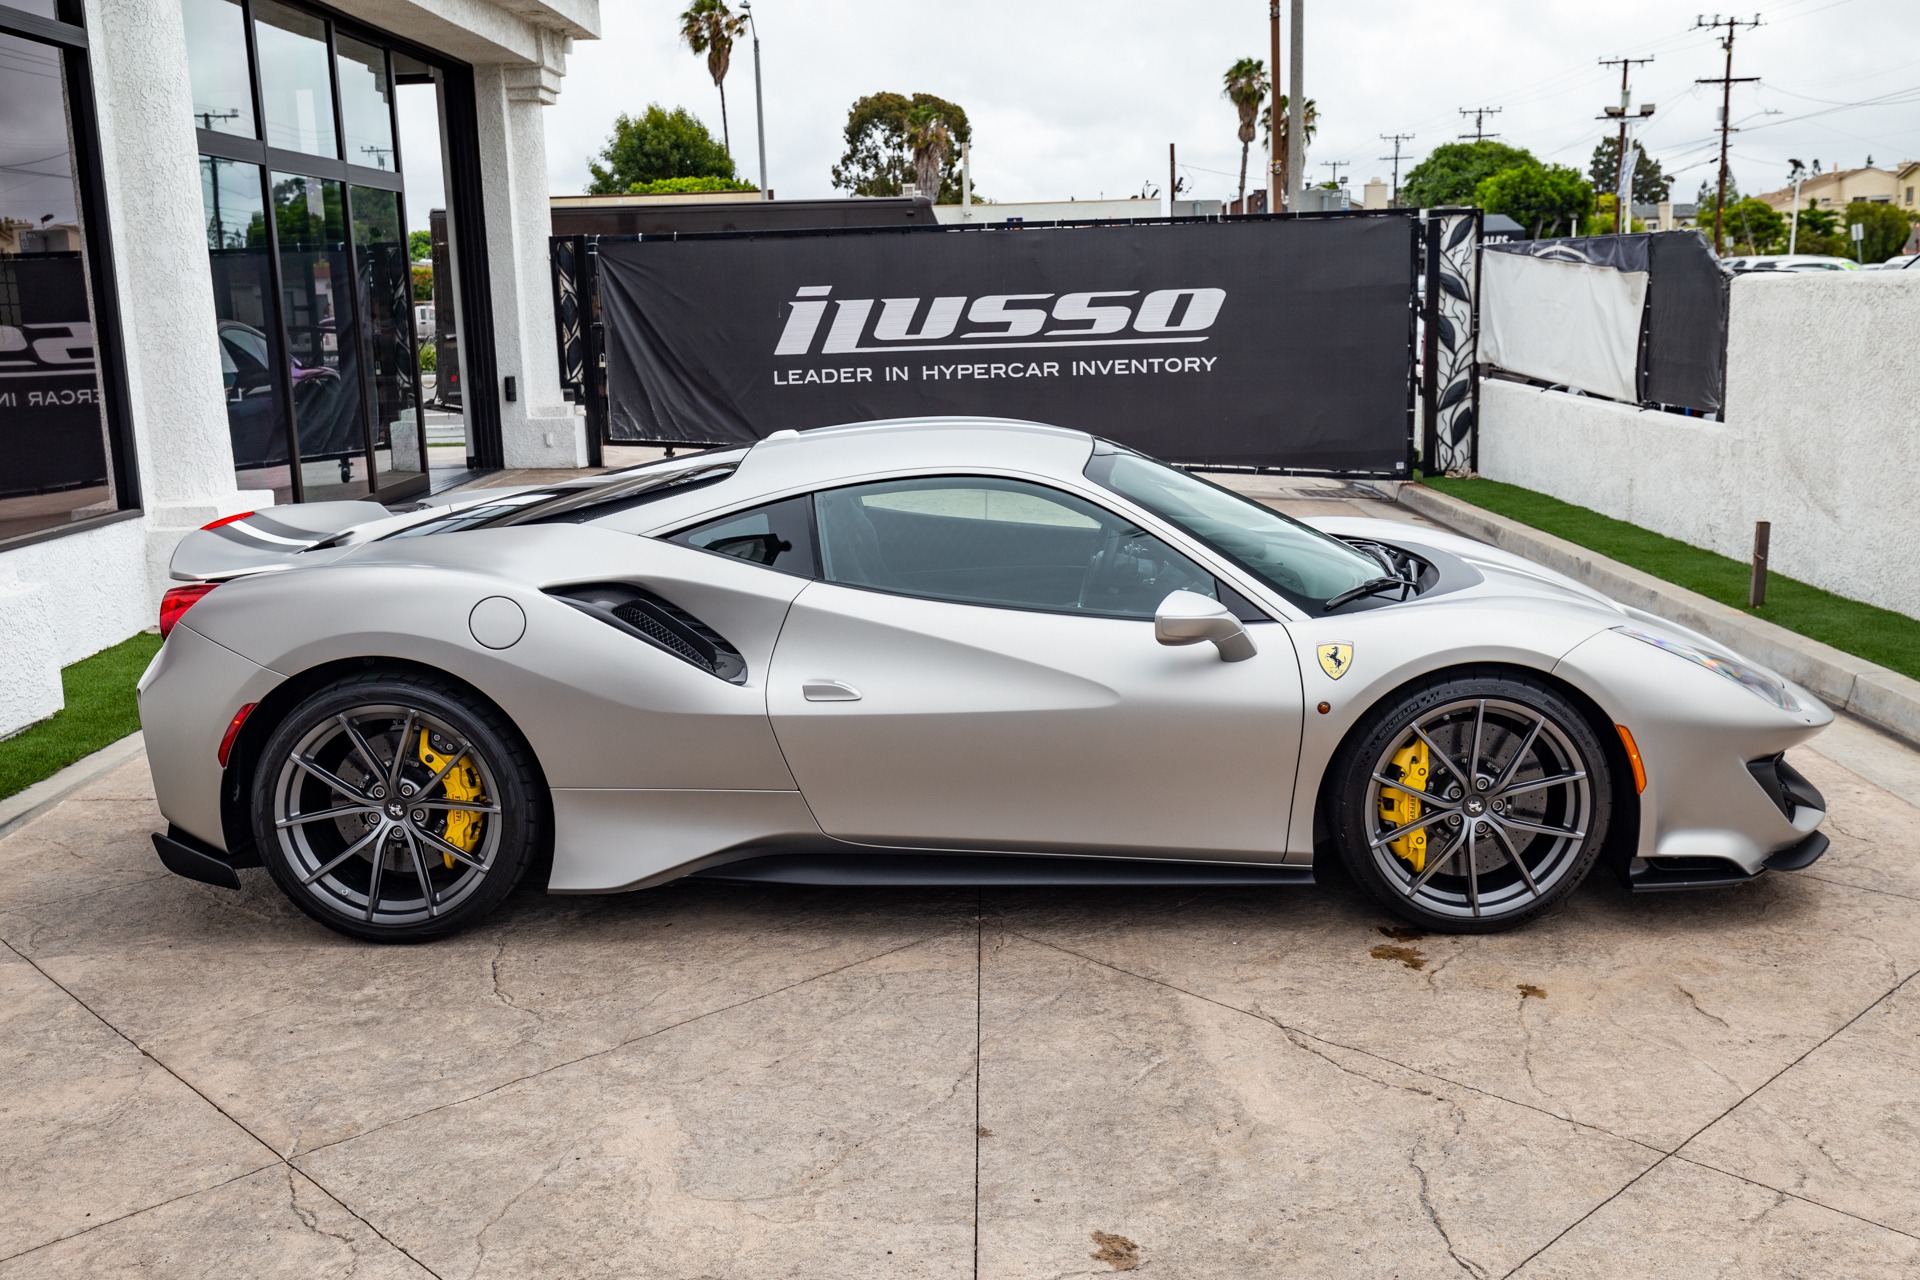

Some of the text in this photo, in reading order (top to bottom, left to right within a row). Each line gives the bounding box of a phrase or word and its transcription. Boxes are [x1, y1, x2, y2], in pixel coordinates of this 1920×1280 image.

[774, 356, 1218, 386] LEADER IN HYPERCAR INVENTORY
[1379, 702, 1419, 739] MICHELIN
